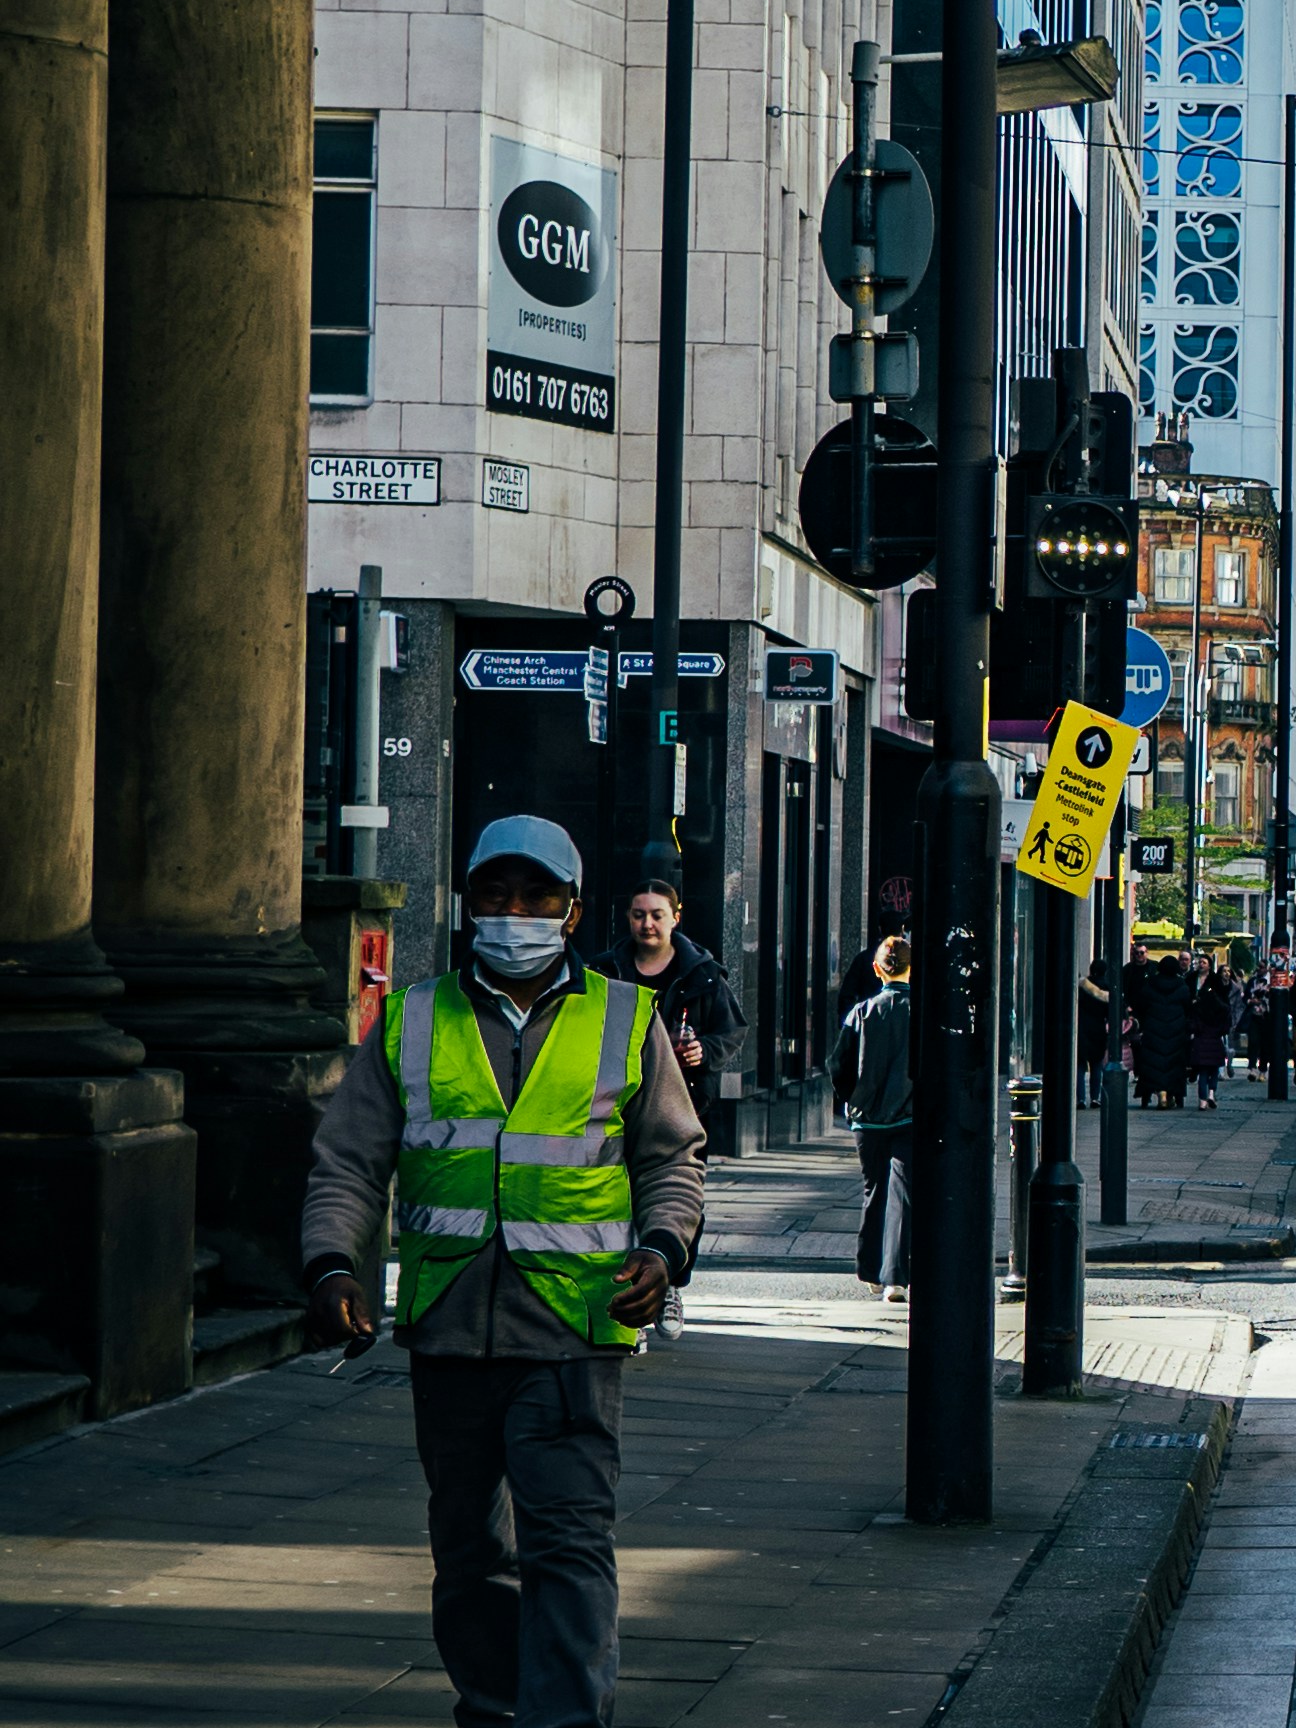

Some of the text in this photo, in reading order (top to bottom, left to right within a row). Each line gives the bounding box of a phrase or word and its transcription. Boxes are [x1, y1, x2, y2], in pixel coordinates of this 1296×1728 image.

[517, 213, 591, 274] GGM
[492, 365, 609, 421] 0161 707 6763
[310, 459, 436, 480] CHARLOTTE
[489, 465, 524, 486] MOSLEY
[332, 481, 413, 501] STREET
[489, 486, 523, 508] STREET
[483, 655, 547, 665] Chinese Arch
[633, 658, 645, 668] St
[483, 665, 578, 676] Manchester Central
[496, 675, 566, 686] Coach Station
[383, 737, 412, 757] 59
[1060, 765, 1107, 793] Deansgate
[1055, 793, 1095, 818] Metrolink
[1061, 812, 1080, 827] stop
